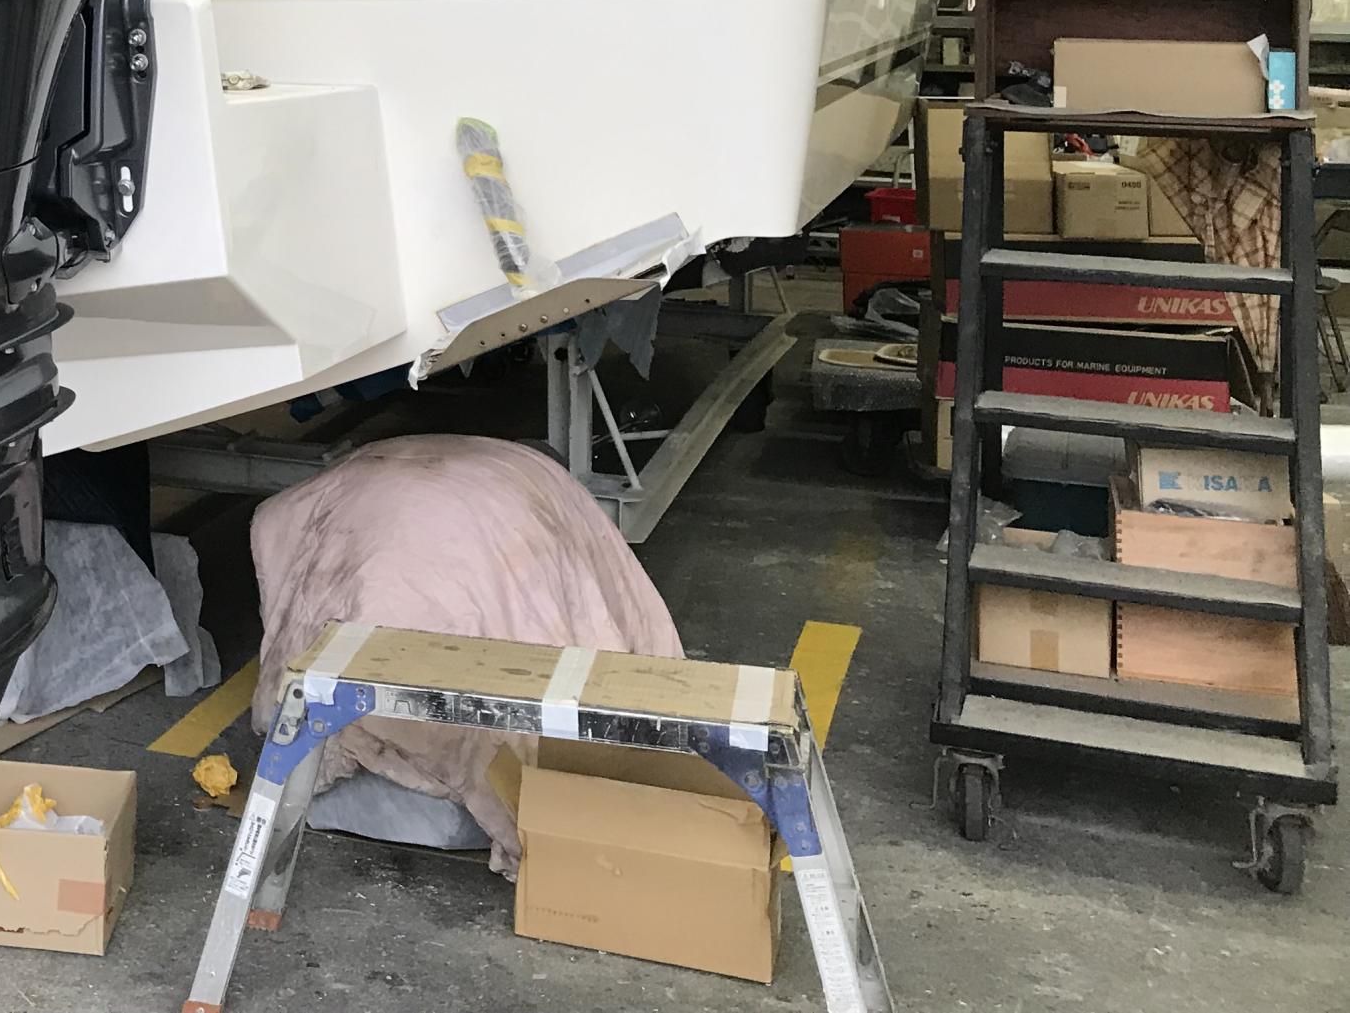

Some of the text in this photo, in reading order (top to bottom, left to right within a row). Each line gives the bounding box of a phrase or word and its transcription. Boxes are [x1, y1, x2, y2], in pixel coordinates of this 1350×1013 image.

[1137, 295, 1227, 315] UNIKAS
[1004, 355, 1168, 375] PRODUCTS FOR MARINE EQUIPMENT
[1126, 390, 1215, 410] UNIKAS
